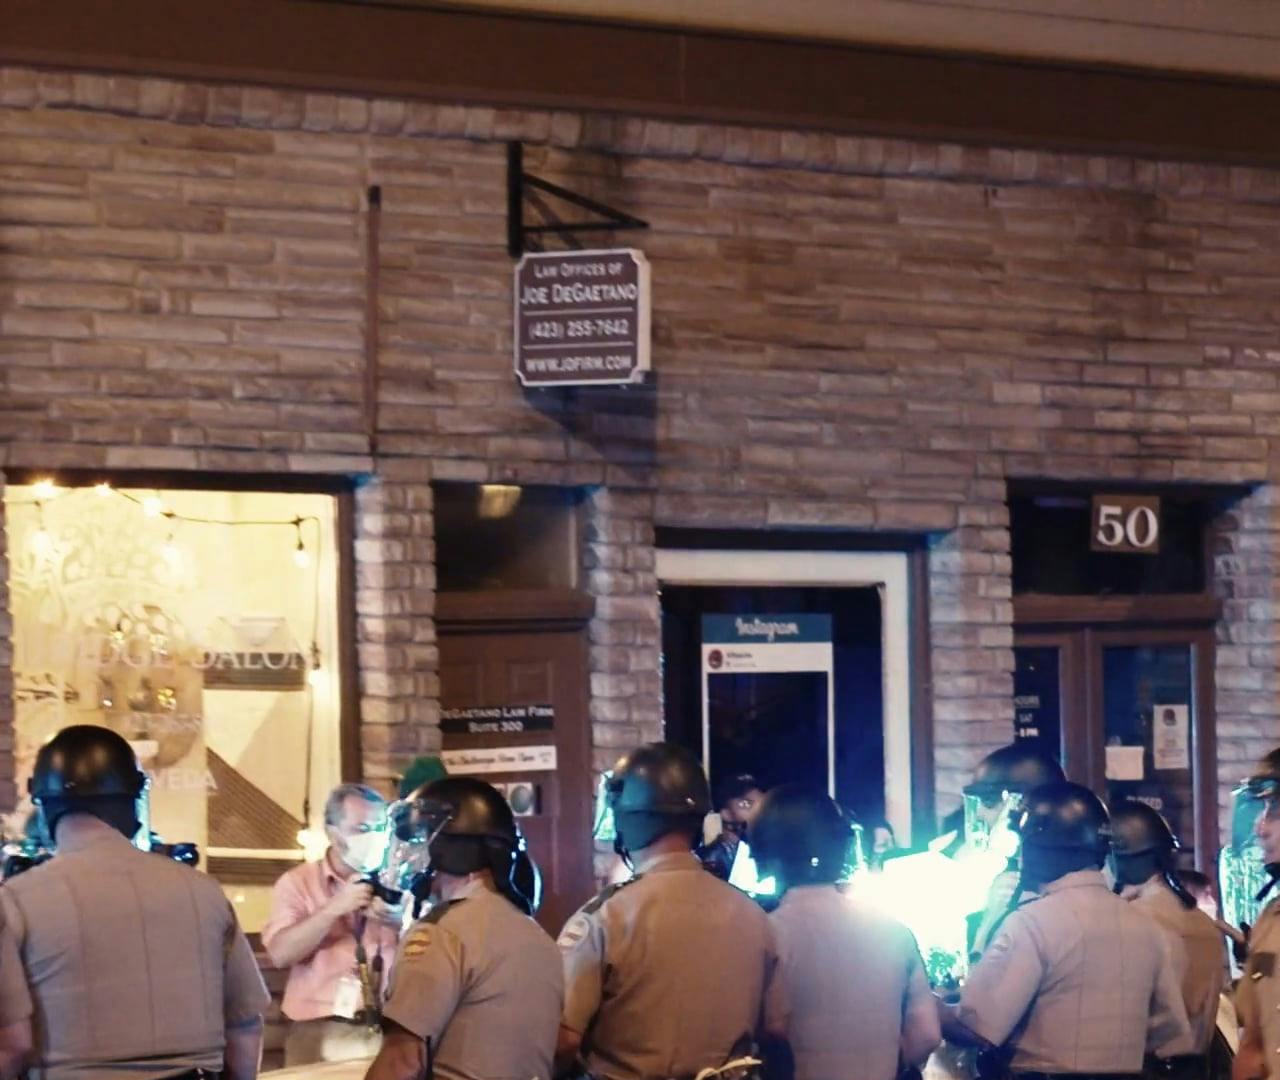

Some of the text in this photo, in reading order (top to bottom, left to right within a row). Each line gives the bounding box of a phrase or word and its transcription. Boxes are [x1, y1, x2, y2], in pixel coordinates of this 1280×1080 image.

[534, 262, 624, 278] LAW OFFICES OF
[521, 285, 549, 304] JOE
[529, 321, 564, 339] (423)
[1096, 504, 1158, 548] 50
[192, 636, 312, 670] SALON
